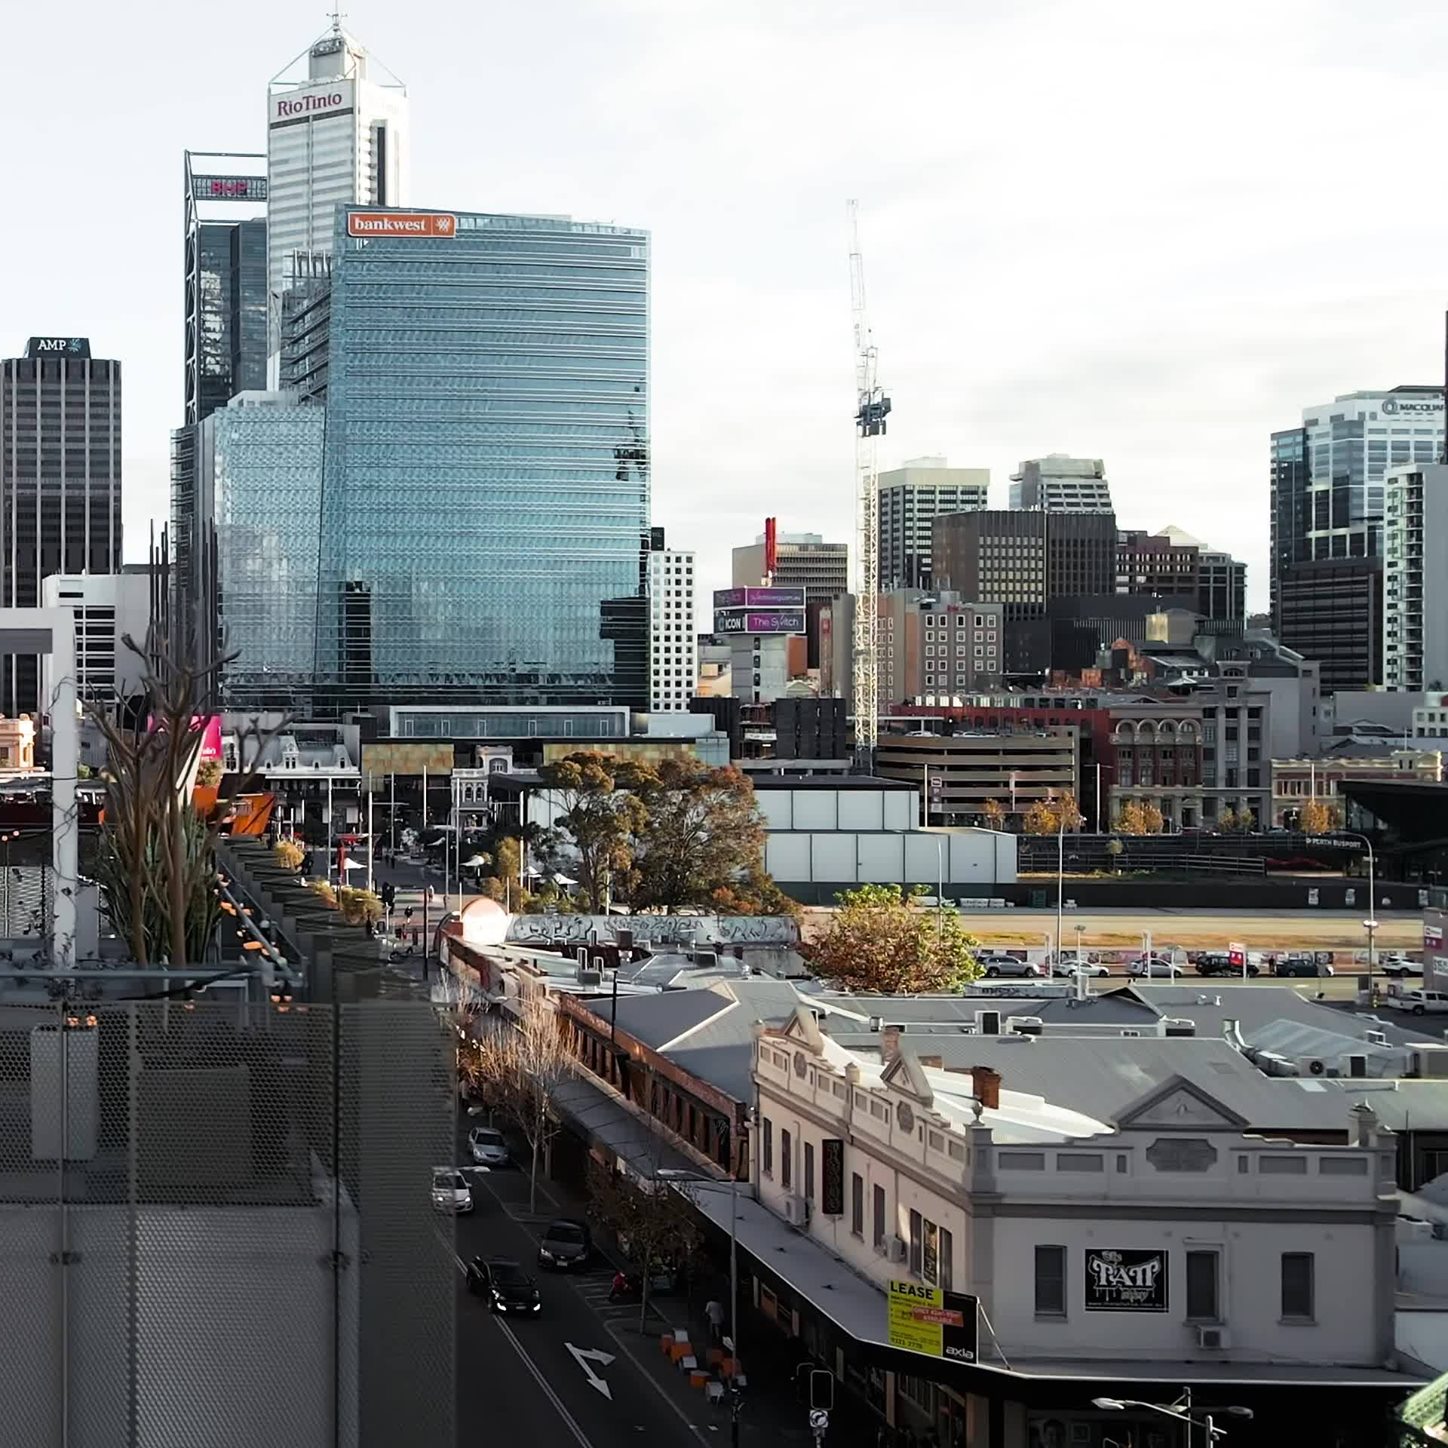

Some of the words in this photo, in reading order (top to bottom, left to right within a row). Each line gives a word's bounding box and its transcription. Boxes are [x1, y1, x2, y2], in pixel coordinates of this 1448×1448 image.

[354, 216, 426, 231] bankwest
[37, 339, 67, 351] AMP
[725, 617, 741, 630] ICON
[753, 617, 770, 626] The
[771, 615, 799, 629] Switch
[1092, 1259, 1159, 1286] TATT
[890, 1280, 934, 1300] LEASE
[945, 1346, 974, 1359] axia
